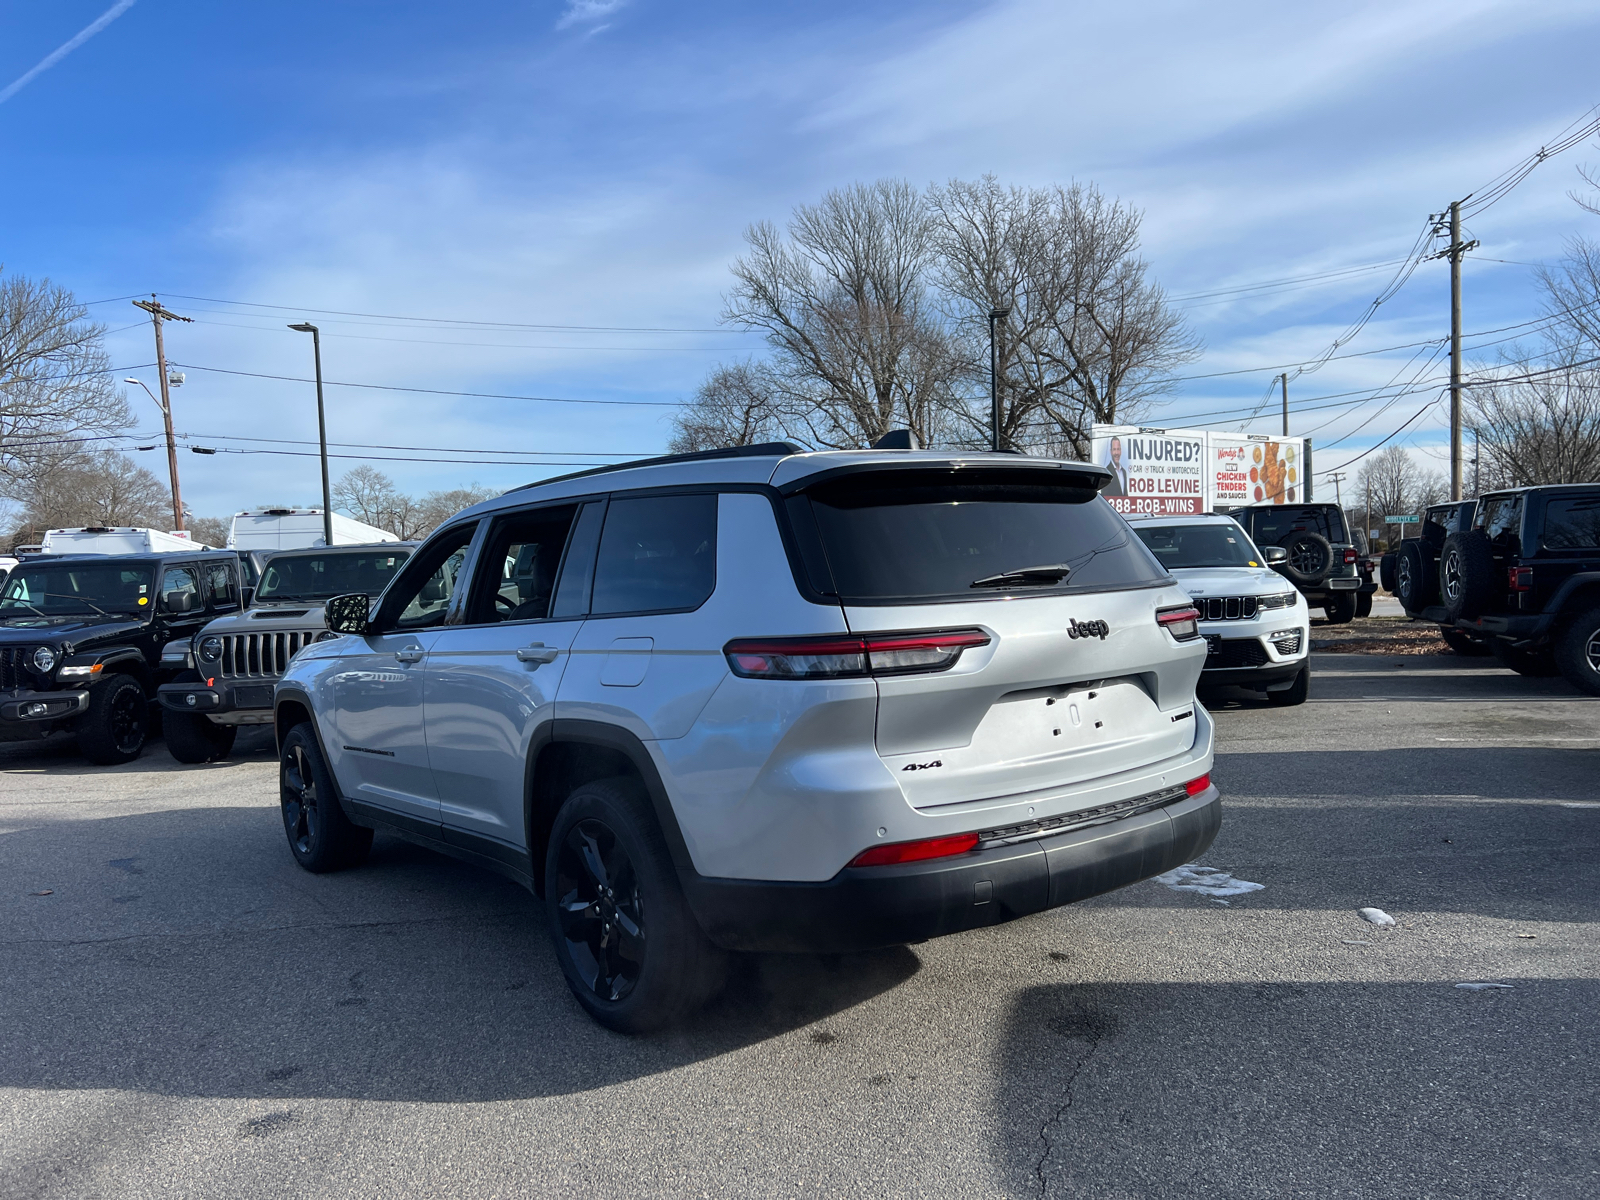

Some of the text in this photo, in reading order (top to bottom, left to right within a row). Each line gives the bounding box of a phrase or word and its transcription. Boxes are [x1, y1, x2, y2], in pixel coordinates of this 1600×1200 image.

[1128, 438, 1200, 463] INJURED?
[1133, 465, 1199, 475] CAR TRUCK MOTORCYCLE
[1216, 472, 1247, 481] CHICKEN
[1129, 478, 1200, 493] ROB LEVINE
[1216, 482, 1247, 491] TENDERS
[1066, 617, 1110, 641] Jeep
